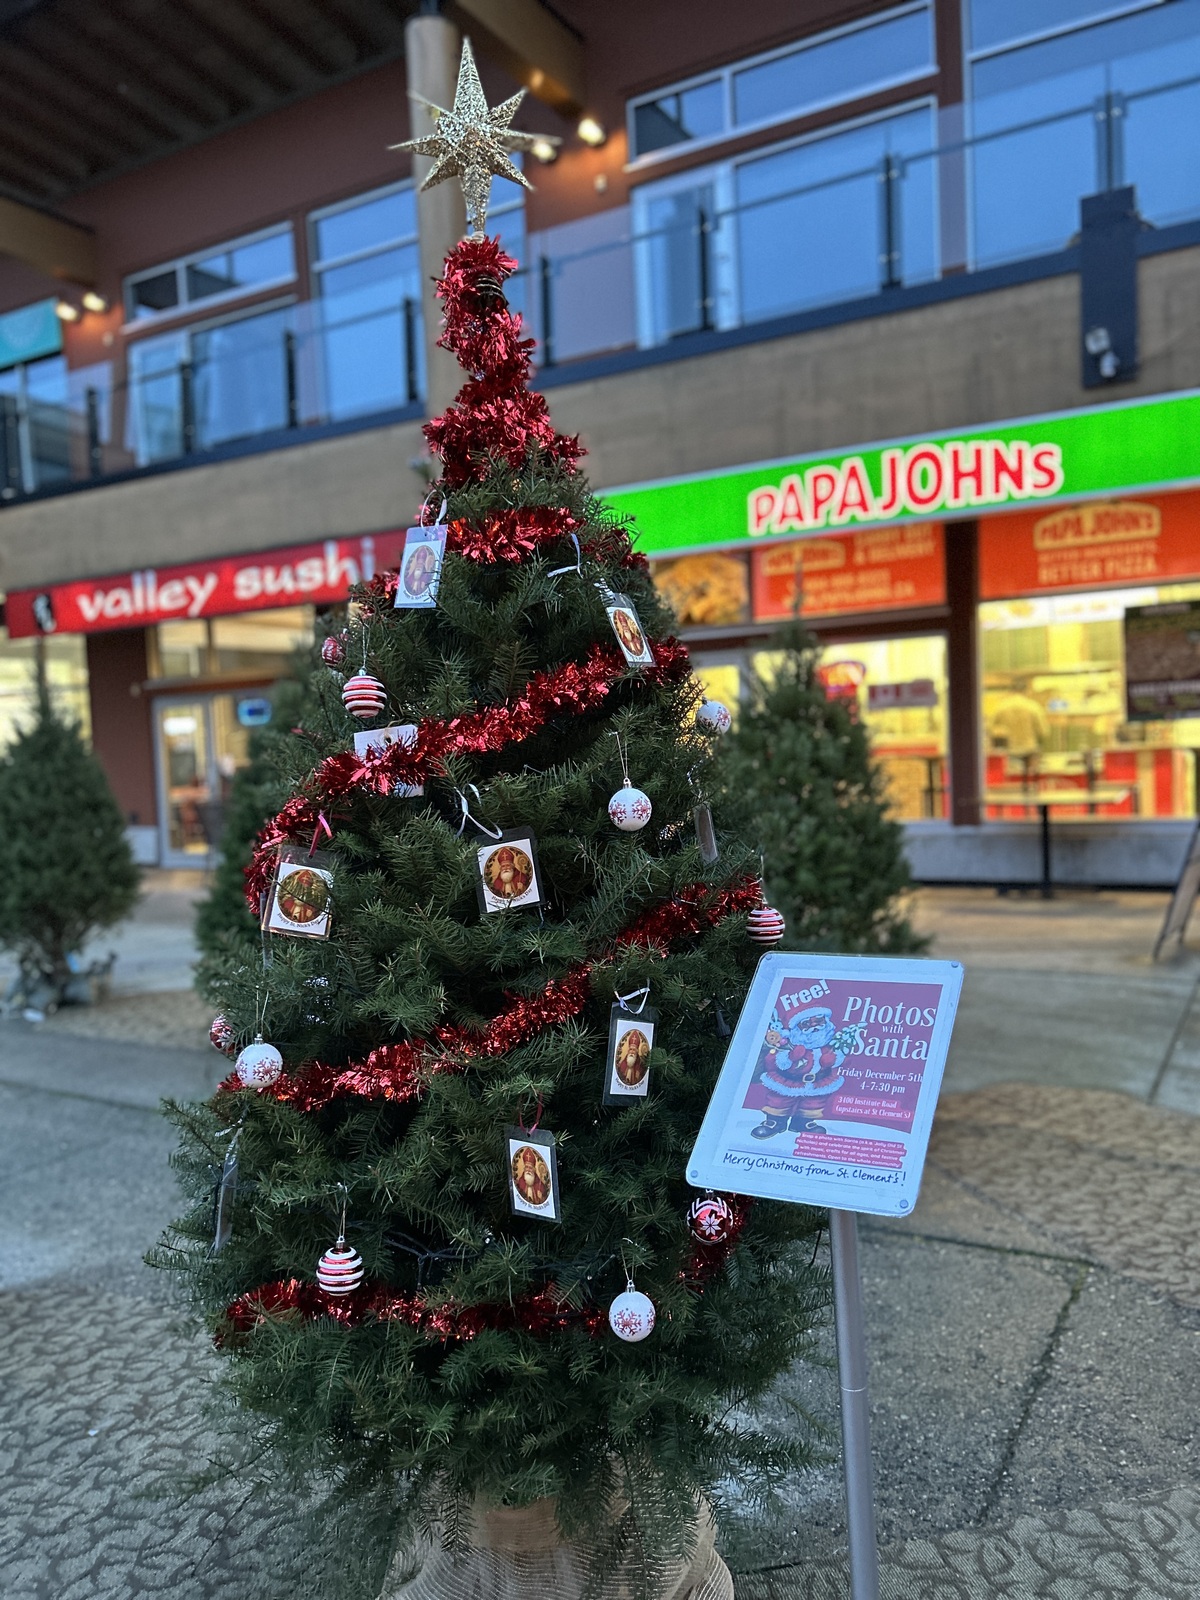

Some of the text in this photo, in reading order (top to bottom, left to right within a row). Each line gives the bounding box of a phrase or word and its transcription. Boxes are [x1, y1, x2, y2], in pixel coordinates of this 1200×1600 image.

[750, 441, 1063, 536] PAPA JOHNS
[76, 536, 377, 618] valley sushi
[780, 979, 831, 1011] Free!
[842, 996, 936, 1027] Photos
[882, 1024, 904, 1034] with
[851, 1028, 928, 1060] Santa
[837, 1066, 924, 1083] Friday December 5th
[891, 1086, 906, 1095] pm
[835, 1104, 863, 1114] (upstairs
[882, 1100, 898, 1109] Road
[722, 1153, 756, 1171] Merry
[756, 1157, 804, 1174] Christmas
[805, 1164, 834, 1176] from
[836, 1168, 850, 1179] St.
